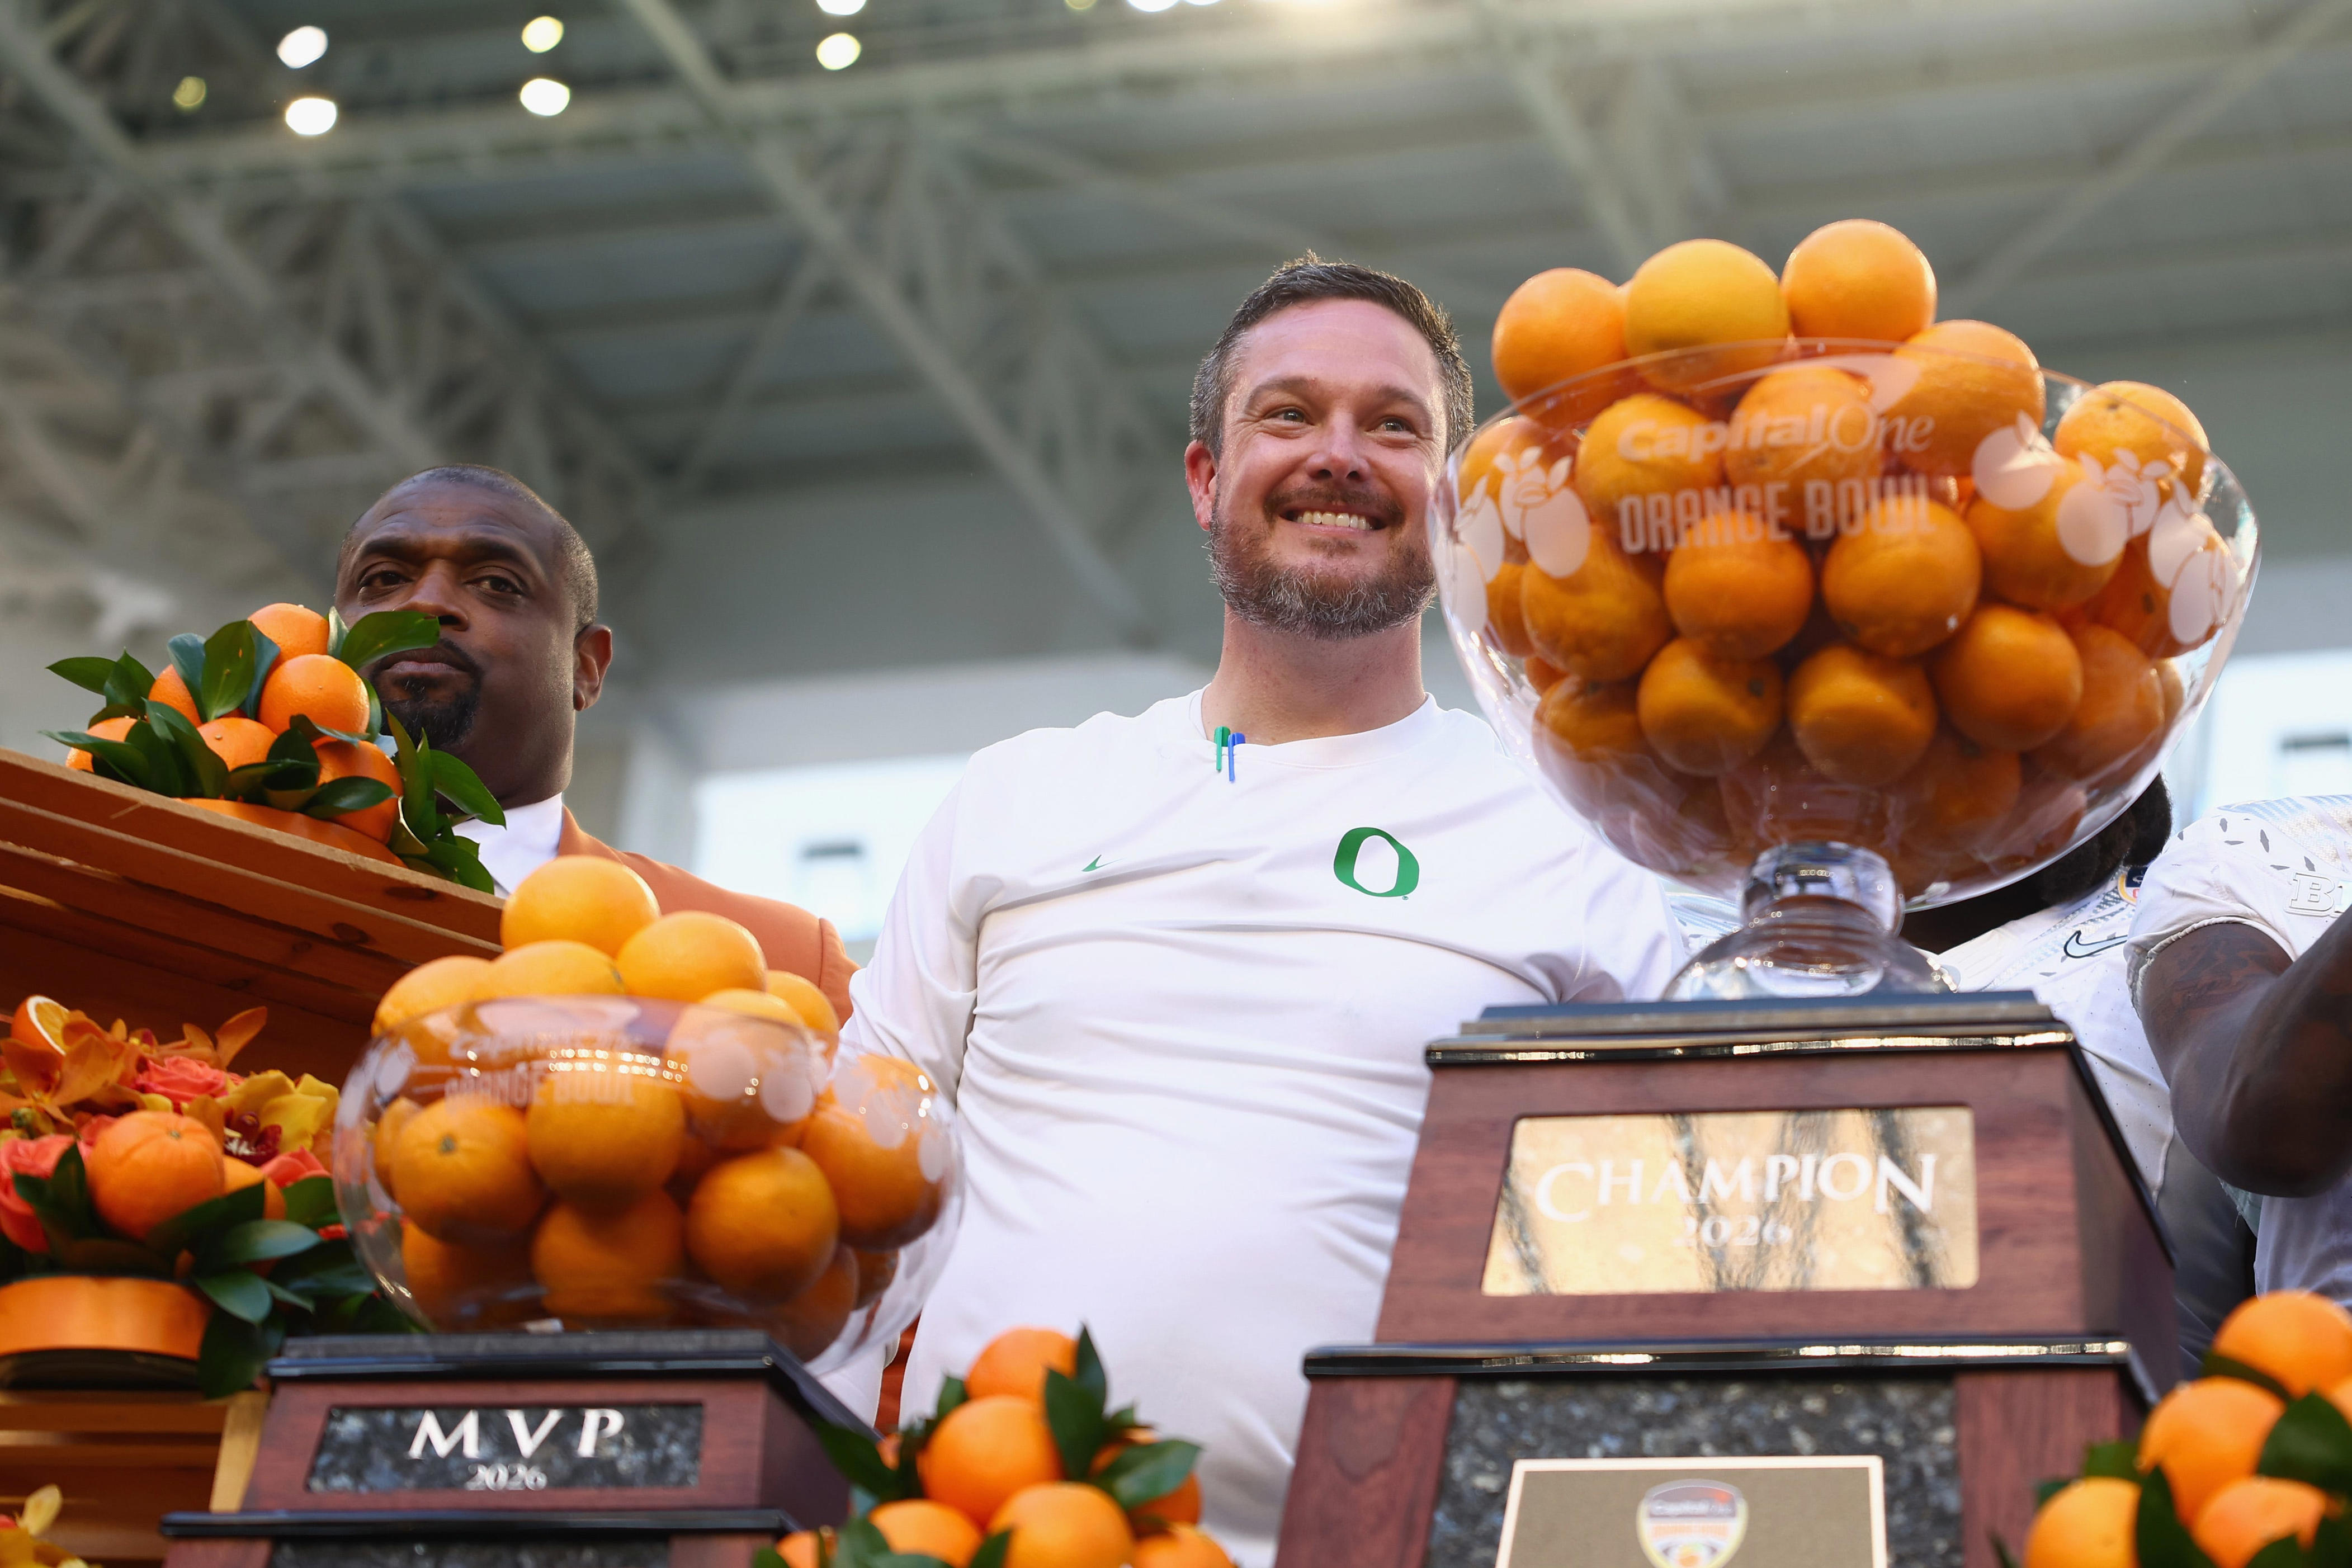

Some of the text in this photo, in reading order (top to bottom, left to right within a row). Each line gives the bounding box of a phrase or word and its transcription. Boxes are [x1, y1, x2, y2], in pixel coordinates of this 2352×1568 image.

[1619, 474, 1937, 554] ORANGE BOWL
[1334, 827, 1419, 897] O
[1535, 1152, 1937, 1222] CHAMPION
[1672, 1215, 1792, 1248] 2026
[465, 1463, 547, 1491] 2026
